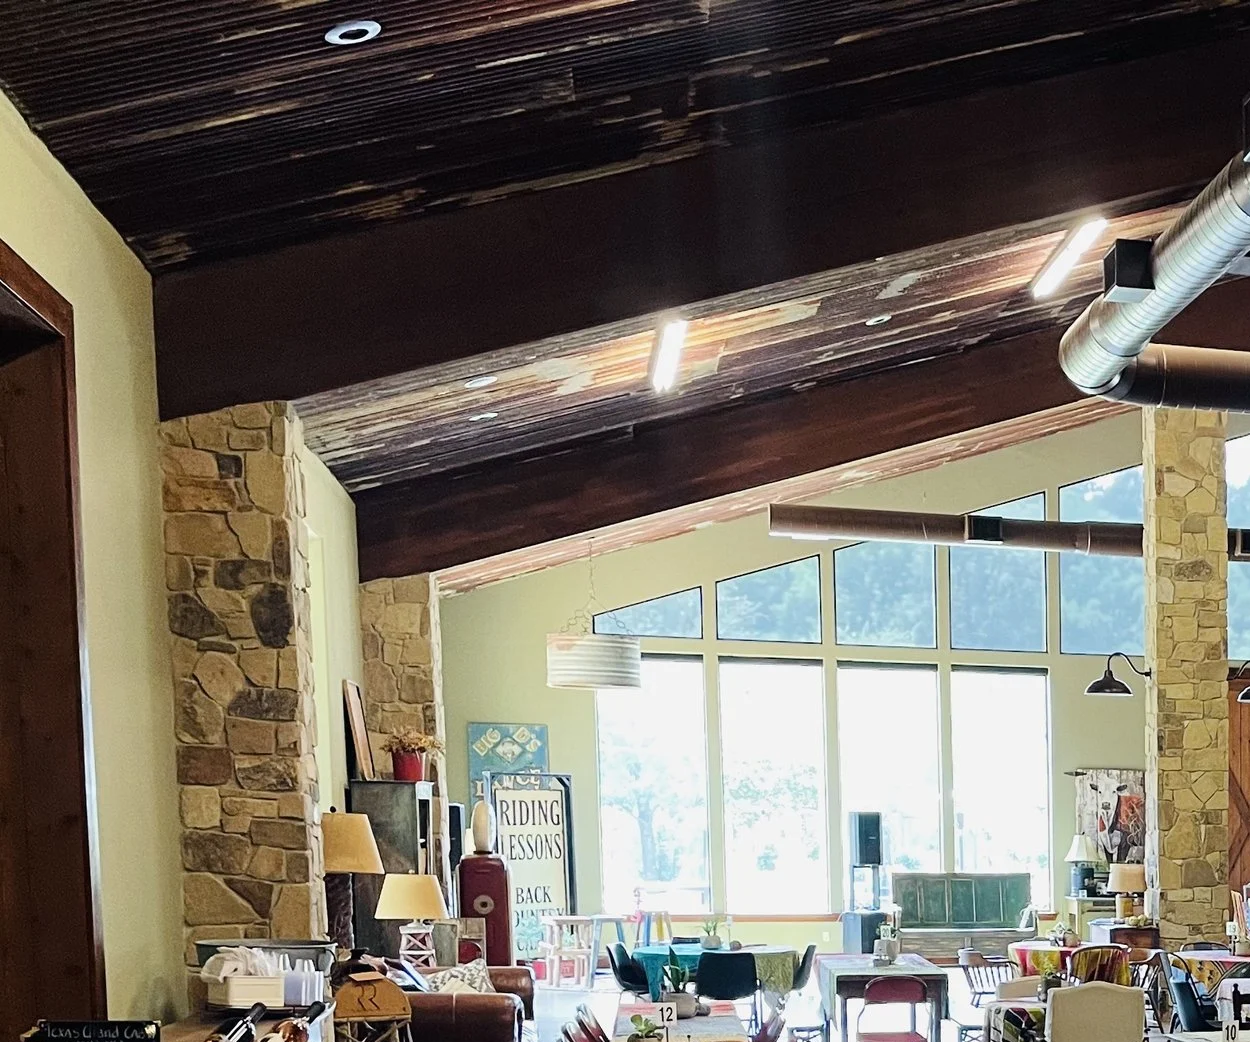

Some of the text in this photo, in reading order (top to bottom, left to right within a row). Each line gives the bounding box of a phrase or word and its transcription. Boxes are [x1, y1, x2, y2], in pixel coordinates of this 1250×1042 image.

[499, 800, 560, 826] RIDING
[501, 833, 562, 861] LESSONS
[515, 886, 552, 905] BACK
[659, 1006, 673, 1022] 12
[1225, 1024, 1237, 1041] 10
